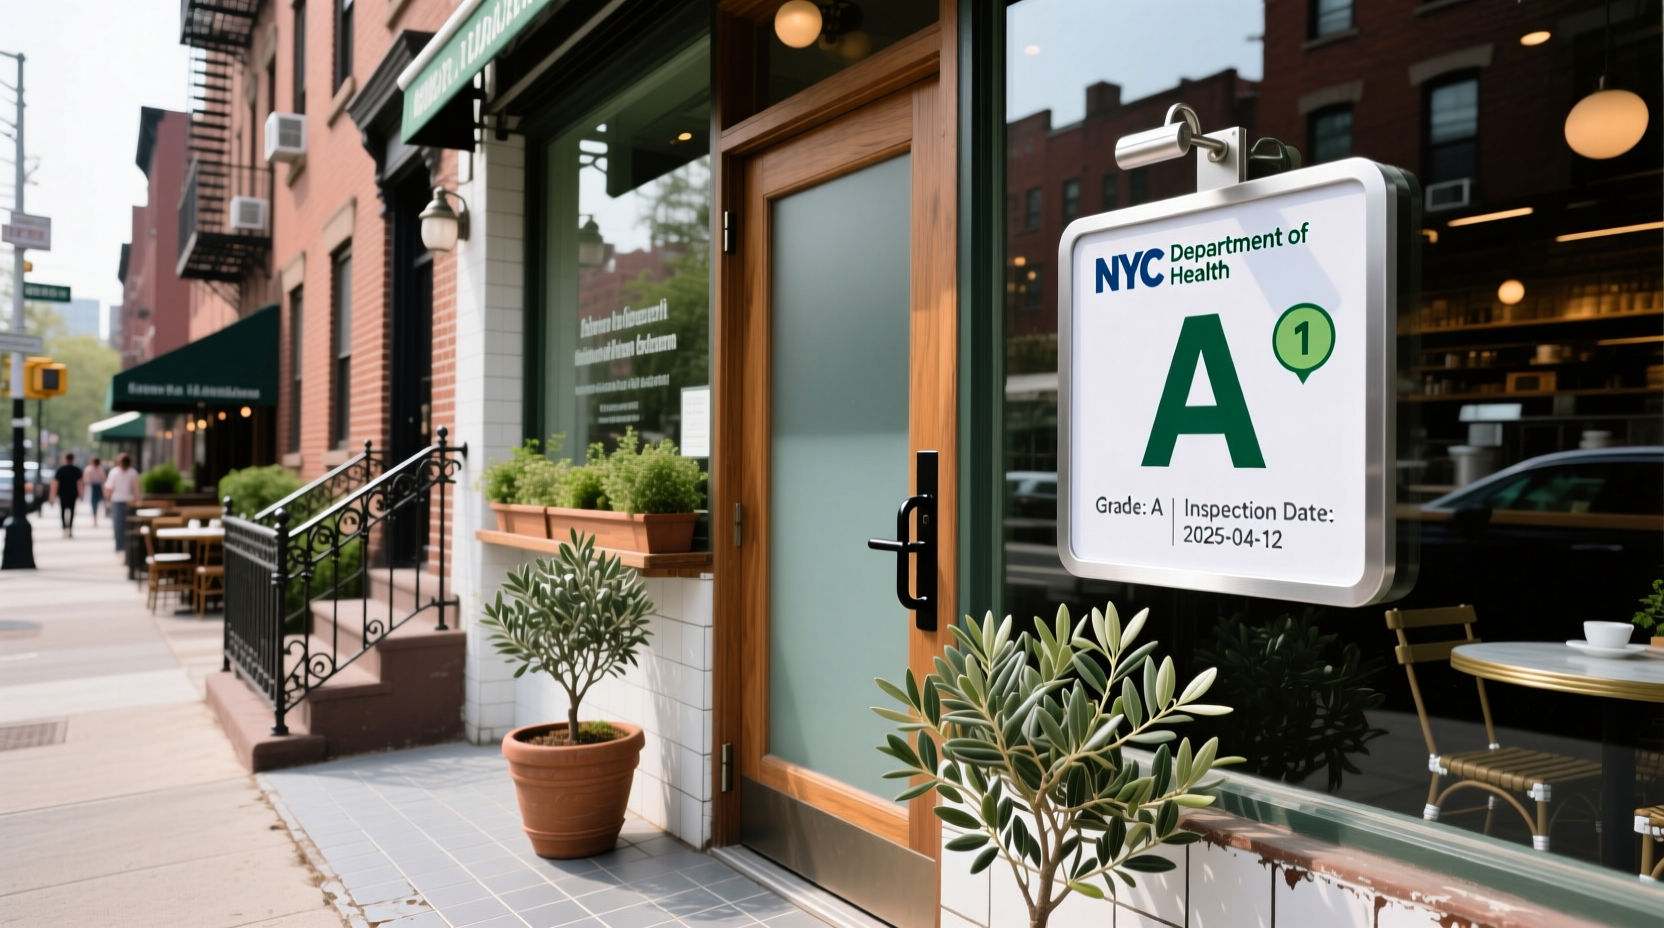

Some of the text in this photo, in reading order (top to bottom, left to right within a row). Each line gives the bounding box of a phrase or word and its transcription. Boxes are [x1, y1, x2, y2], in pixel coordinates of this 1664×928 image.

[1171, 222, 1309, 263] Department of
[1095, 248, 1165, 294] NYC
[1171, 260, 1230, 285] Health
[1294, 321, 1309, 355] 1
[1141, 313, 1266, 469] A
[1095, 496, 1163, 516] Grade: A
[1185, 498, 1334, 523] Inspection Date:
[1183, 525, 1283, 549] 2025-04-12
